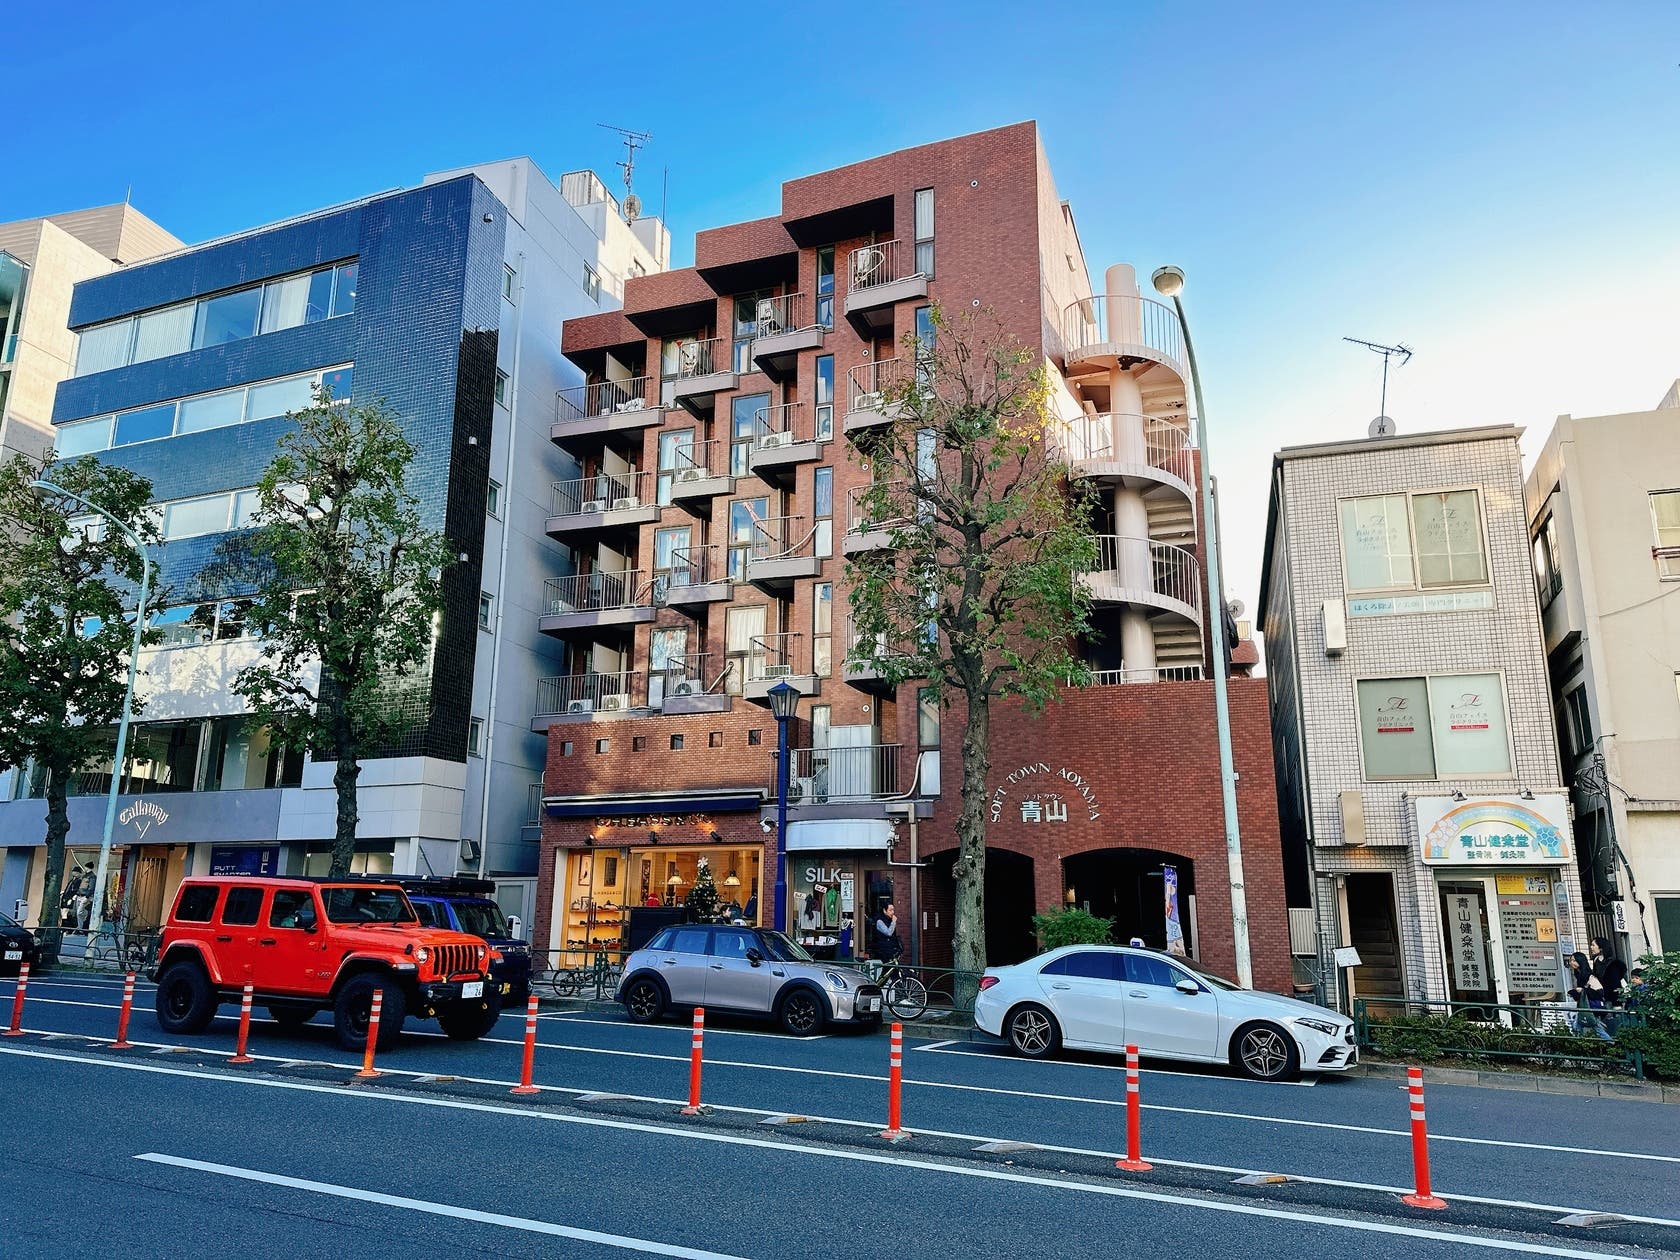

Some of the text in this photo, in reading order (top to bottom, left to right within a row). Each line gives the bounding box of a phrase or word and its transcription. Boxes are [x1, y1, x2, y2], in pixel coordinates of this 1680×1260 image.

[990, 762, 1101, 822] SOFT TOWN AOYAMA
[119, 799, 169, 826] Callaway
[1019, 799, 1068, 823] 青山
[1460, 834, 1530, 848] 青山健楽堂
[805, 867, 842, 883] SILK
[1456, 897, 1476, 961] 青山健楽堂
[1461, 964, 1472, 988] 鍼灸院
[1470, 964, 1481, 988] 整骨院
